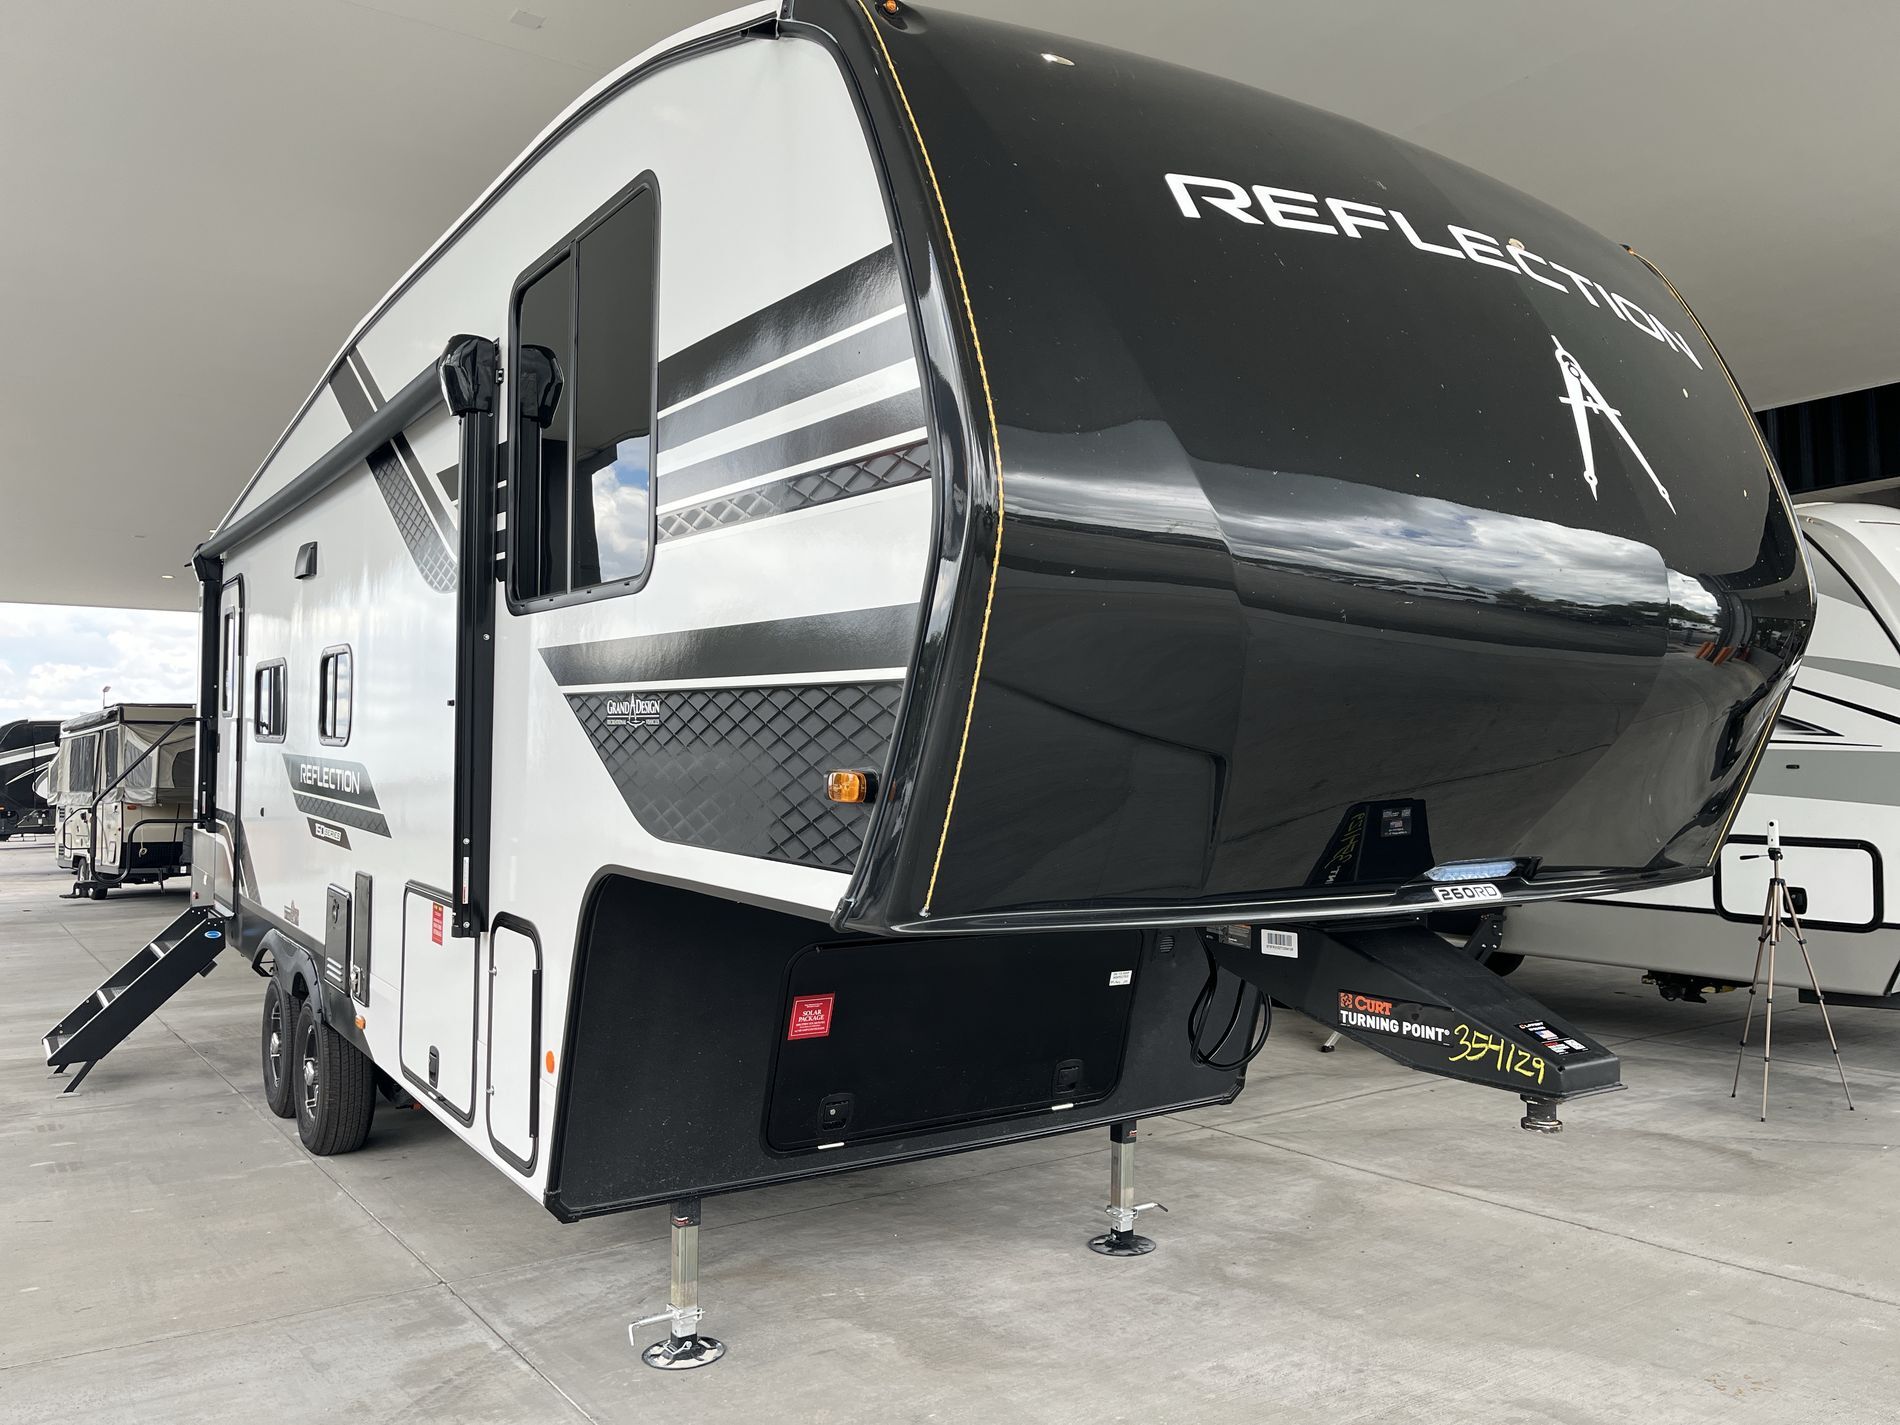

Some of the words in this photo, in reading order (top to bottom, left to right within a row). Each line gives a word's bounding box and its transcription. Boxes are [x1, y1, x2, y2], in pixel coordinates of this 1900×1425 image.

[1164, 173, 1704, 371] REFLECTION
[607, 700, 630, 714] GRAND
[635, 699, 660, 714] DESIGN
[300, 763, 360, 795] REFLECTION
[1438, 885, 1498, 901] 260RD
[1354, 994, 1393, 1016] CURT
[798, 1014, 825, 1022] PACKAGE
[1339, 1009, 1400, 1034] TURNING
[1448, 1024, 1546, 1086] 354129
